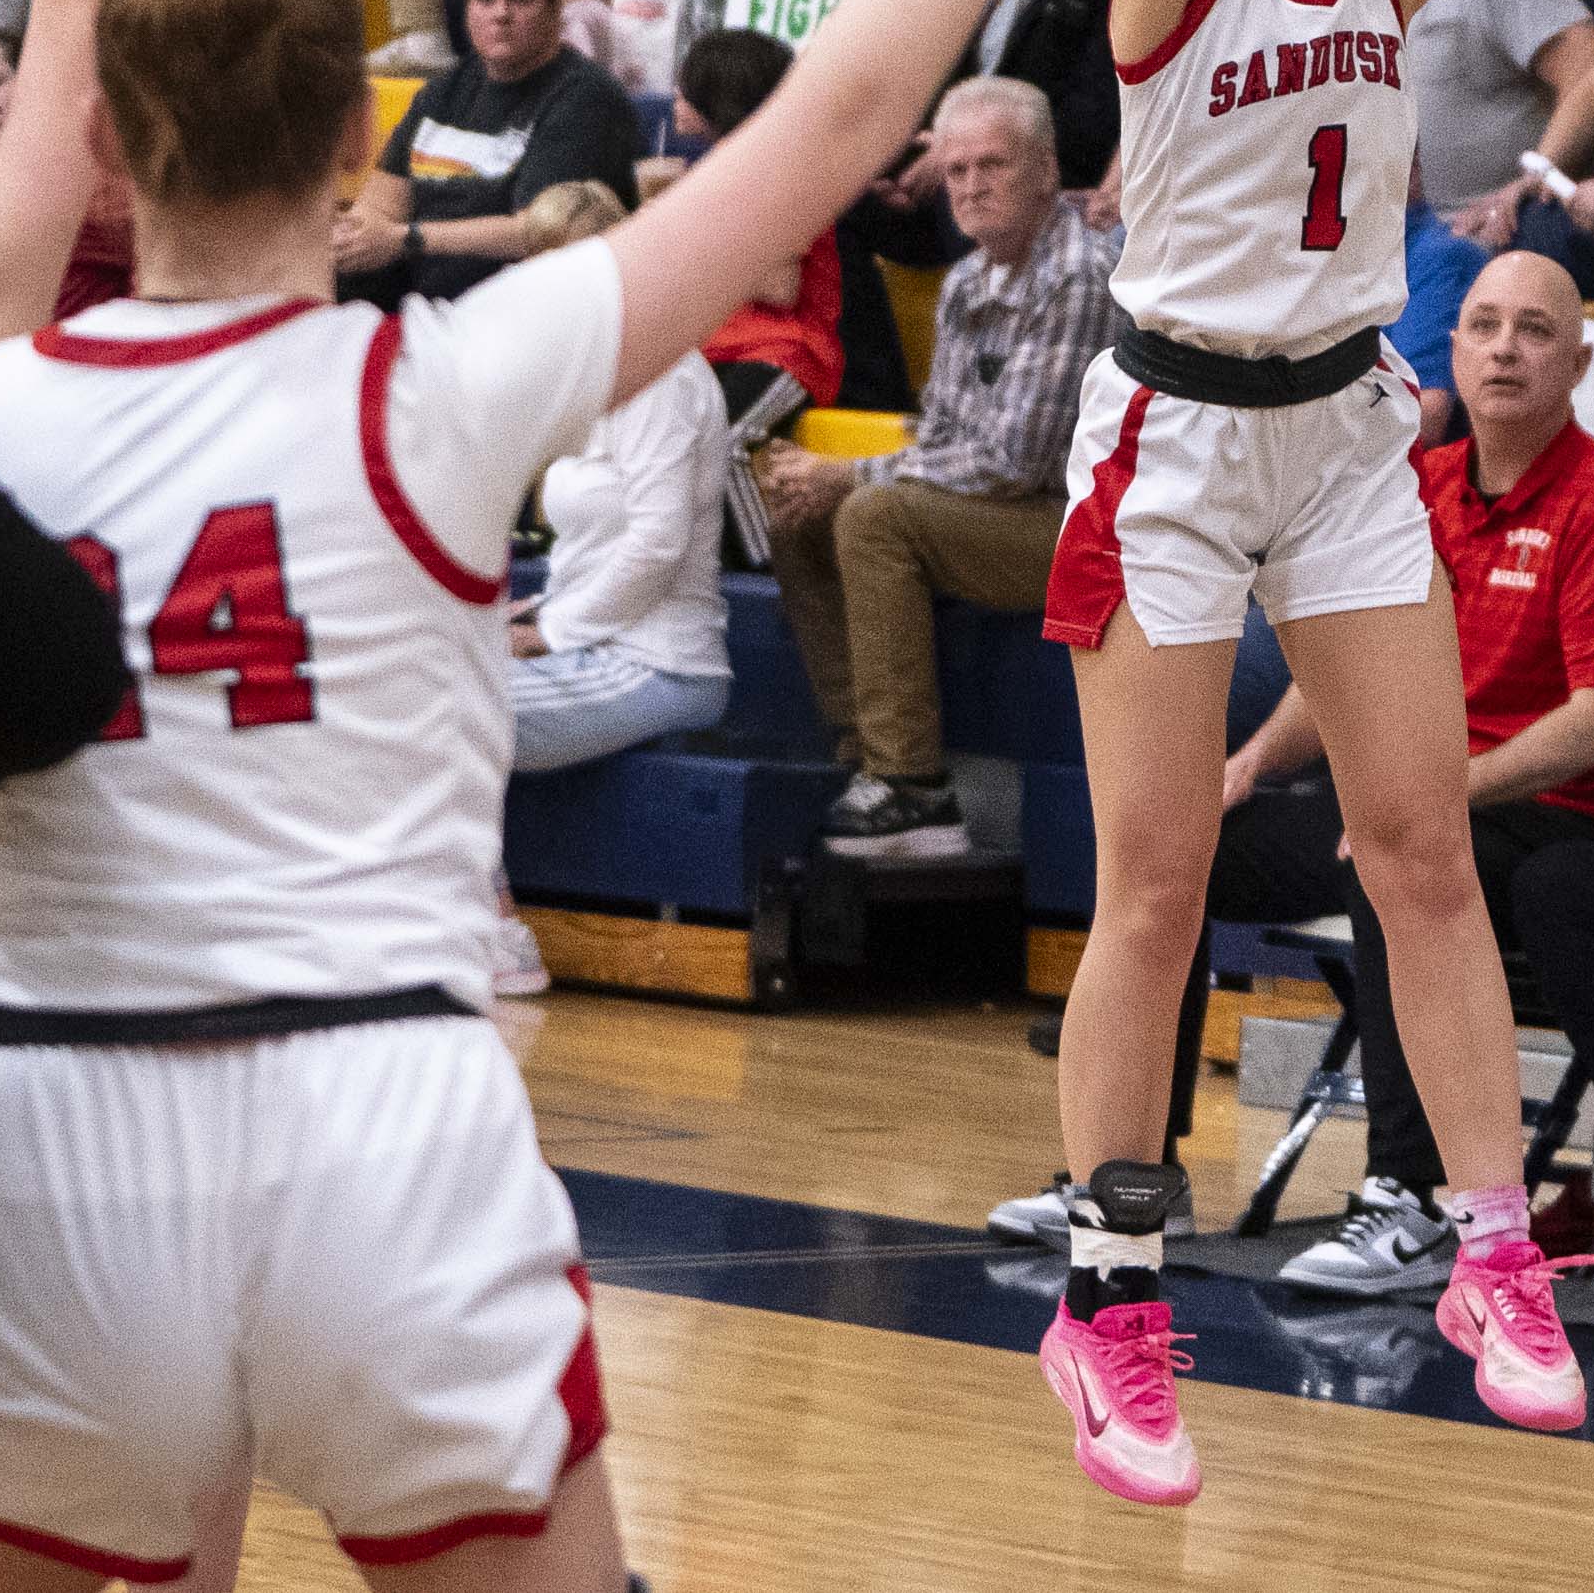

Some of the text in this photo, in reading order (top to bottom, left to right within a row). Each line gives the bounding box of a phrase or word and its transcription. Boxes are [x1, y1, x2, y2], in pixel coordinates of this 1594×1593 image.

[1208, 30, 1401, 118] SANDUSK
[1300, 123, 1348, 251] 1
[65, 496, 315, 743] 4
